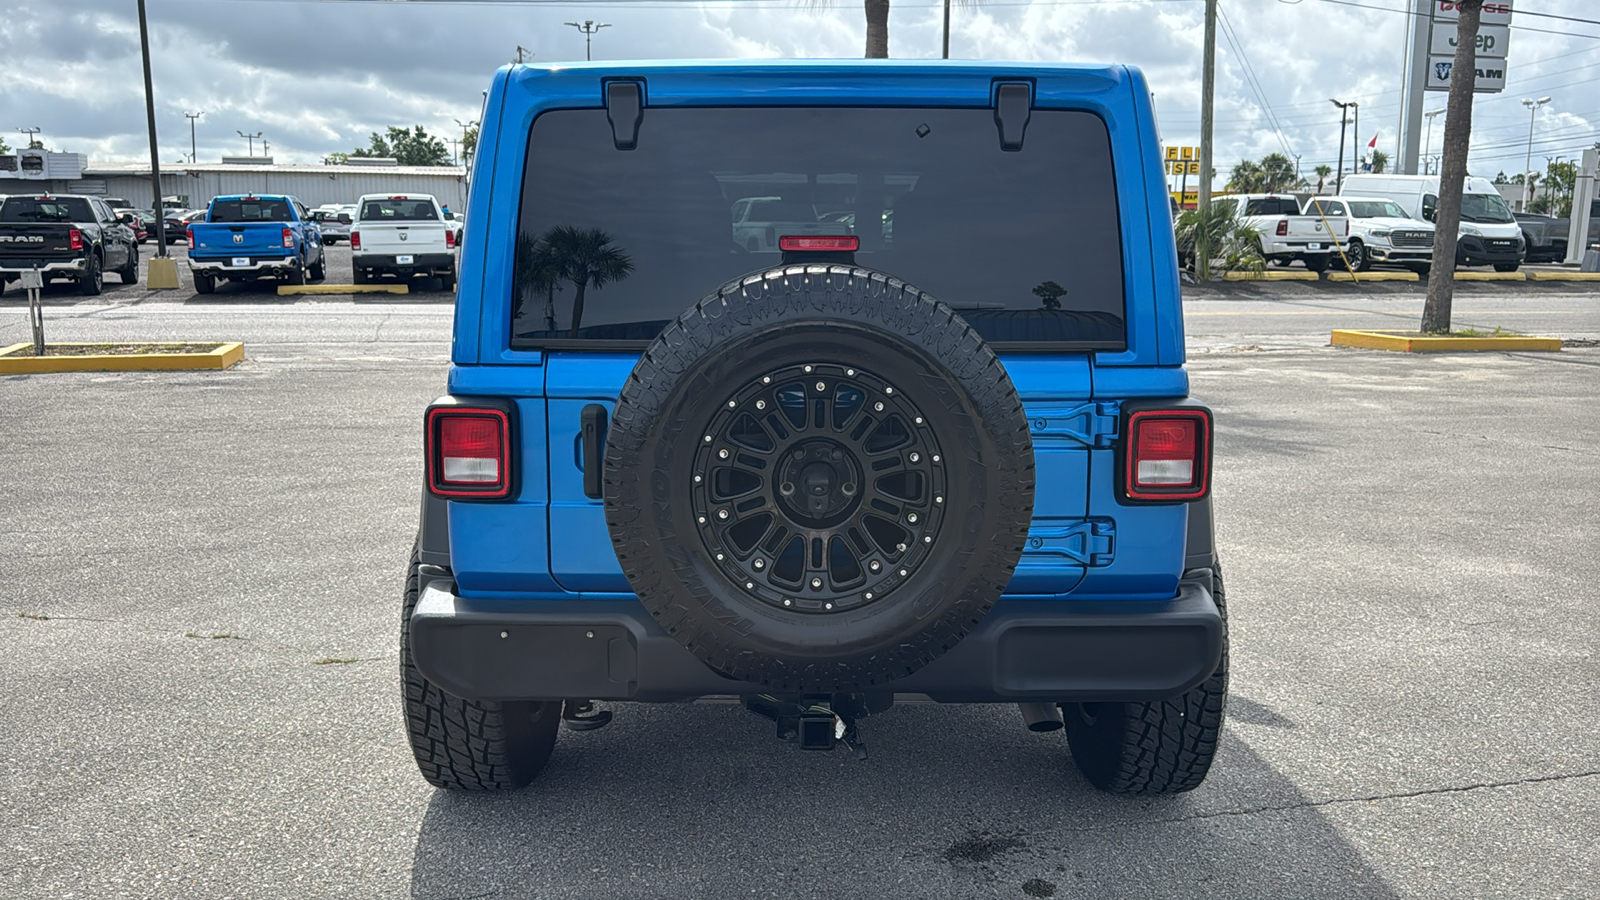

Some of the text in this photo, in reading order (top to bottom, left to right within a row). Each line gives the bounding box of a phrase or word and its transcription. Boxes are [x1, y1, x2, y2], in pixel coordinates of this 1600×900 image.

[1440, 0, 1510, 14] DGE
[1448, 34, 1496, 53] Jep
[1475, 69, 1503, 79] AM
